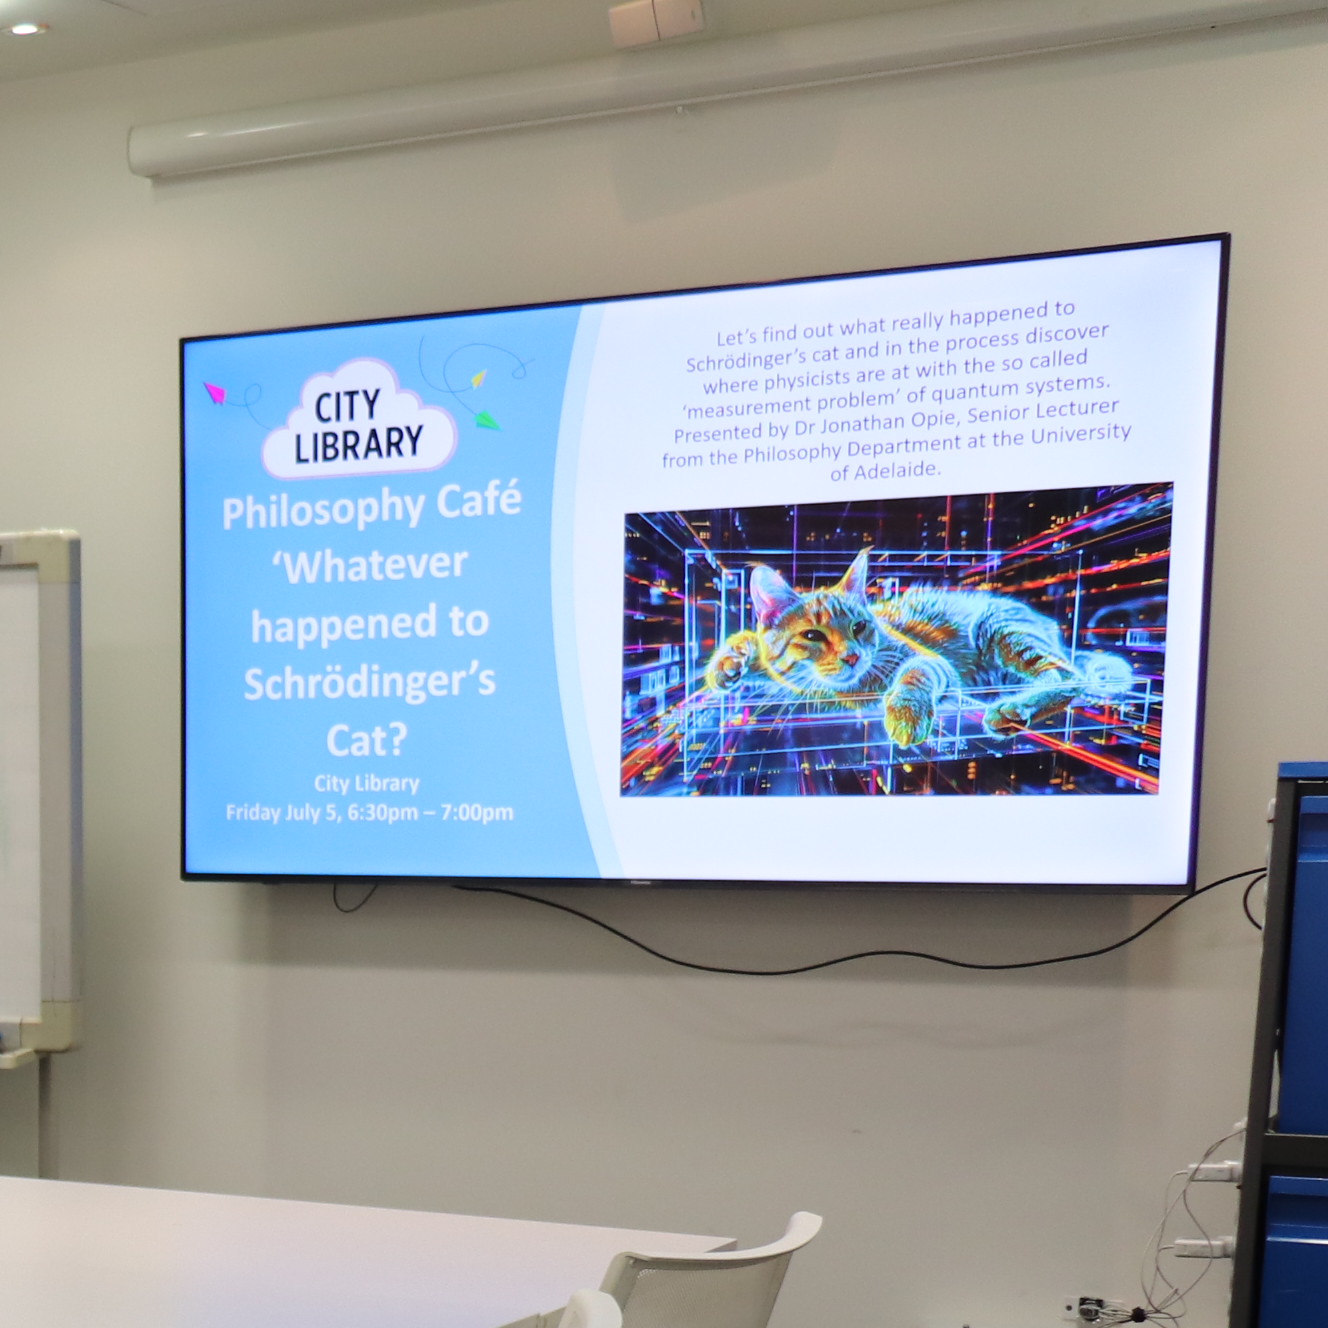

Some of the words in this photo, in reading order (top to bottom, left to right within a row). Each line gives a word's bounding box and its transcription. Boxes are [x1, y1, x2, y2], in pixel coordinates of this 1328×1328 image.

[717, 328, 757, 347] Let’s
[763, 324, 797, 343] find
[803, 322, 834, 339] out
[840, 317, 886, 336] what
[892, 311, 944, 332] really
[949, 300, 1049, 327] happened
[1054, 301, 1076, 316] to
[686, 348, 806, 373] Schrödinger’s
[812, 346, 840, 363] cat
[845, 341, 879, 360] and
[885, 340, 902, 356] in
[909, 338, 939, 354] the
[946, 332, 1019, 355] process
[1026, 323, 1110, 344] discover
[703, 377, 758, 395] where
[764, 369, 850, 394] physicists
[856, 367, 885, 382] are
[892, 364, 909, 381] at
[916, 359, 957, 378] with
[964, 357, 995, 375] the
[1002, 357, 1023, 371] so
[1030, 347, 1088, 369] called
[315, 388, 381, 424] CITY
[683, 397, 811, 420] ‘measurement
[818, 387, 901, 413] problem’
[907, 386, 927, 404] of
[932, 382, 1019, 405] quantum
[1026, 375, 1111, 397] systems.
[295, 424, 423, 465] LIBRARY
[674, 423, 762, 445] Presented
[768, 421, 789, 440] by
[795, 421, 815, 436] Dr
[820, 414, 904, 435] Jonathan
[911, 409, 961, 430] Opie,
[967, 405, 1030, 424] Senior
[1036, 399, 1119, 419] Lecturer
[662, 452, 703, 469] from
[709, 450, 738, 466] the
[744, 443, 842, 464] Philosophy
[847, 434, 961, 458] Department
[967, 433, 986, 449] at
[992, 430, 1024, 447] the
[1031, 423, 1132, 445] University
[830, 465, 849, 482] of
[854, 460, 941, 480] Adelaide.
[223, 486, 426, 532] Philosophy
[437, 478, 522, 519] Café
[272, 548, 469, 584] ‘Whatever
[252, 602, 437, 650] happened
[449, 606, 490, 637] to
[244, 659, 496, 705] Schrödinger’s
[327, 721, 408, 757] Cat?
[314, 774, 350, 796] City
[355, 774, 420, 796] Library
[226, 803, 281, 825] Friday
[285, 804, 321, 825] July
[325, 804, 342, 823] 5,
[347, 804, 419, 825] 6:30pm
[441, 804, 514, 825] 7:00pm
